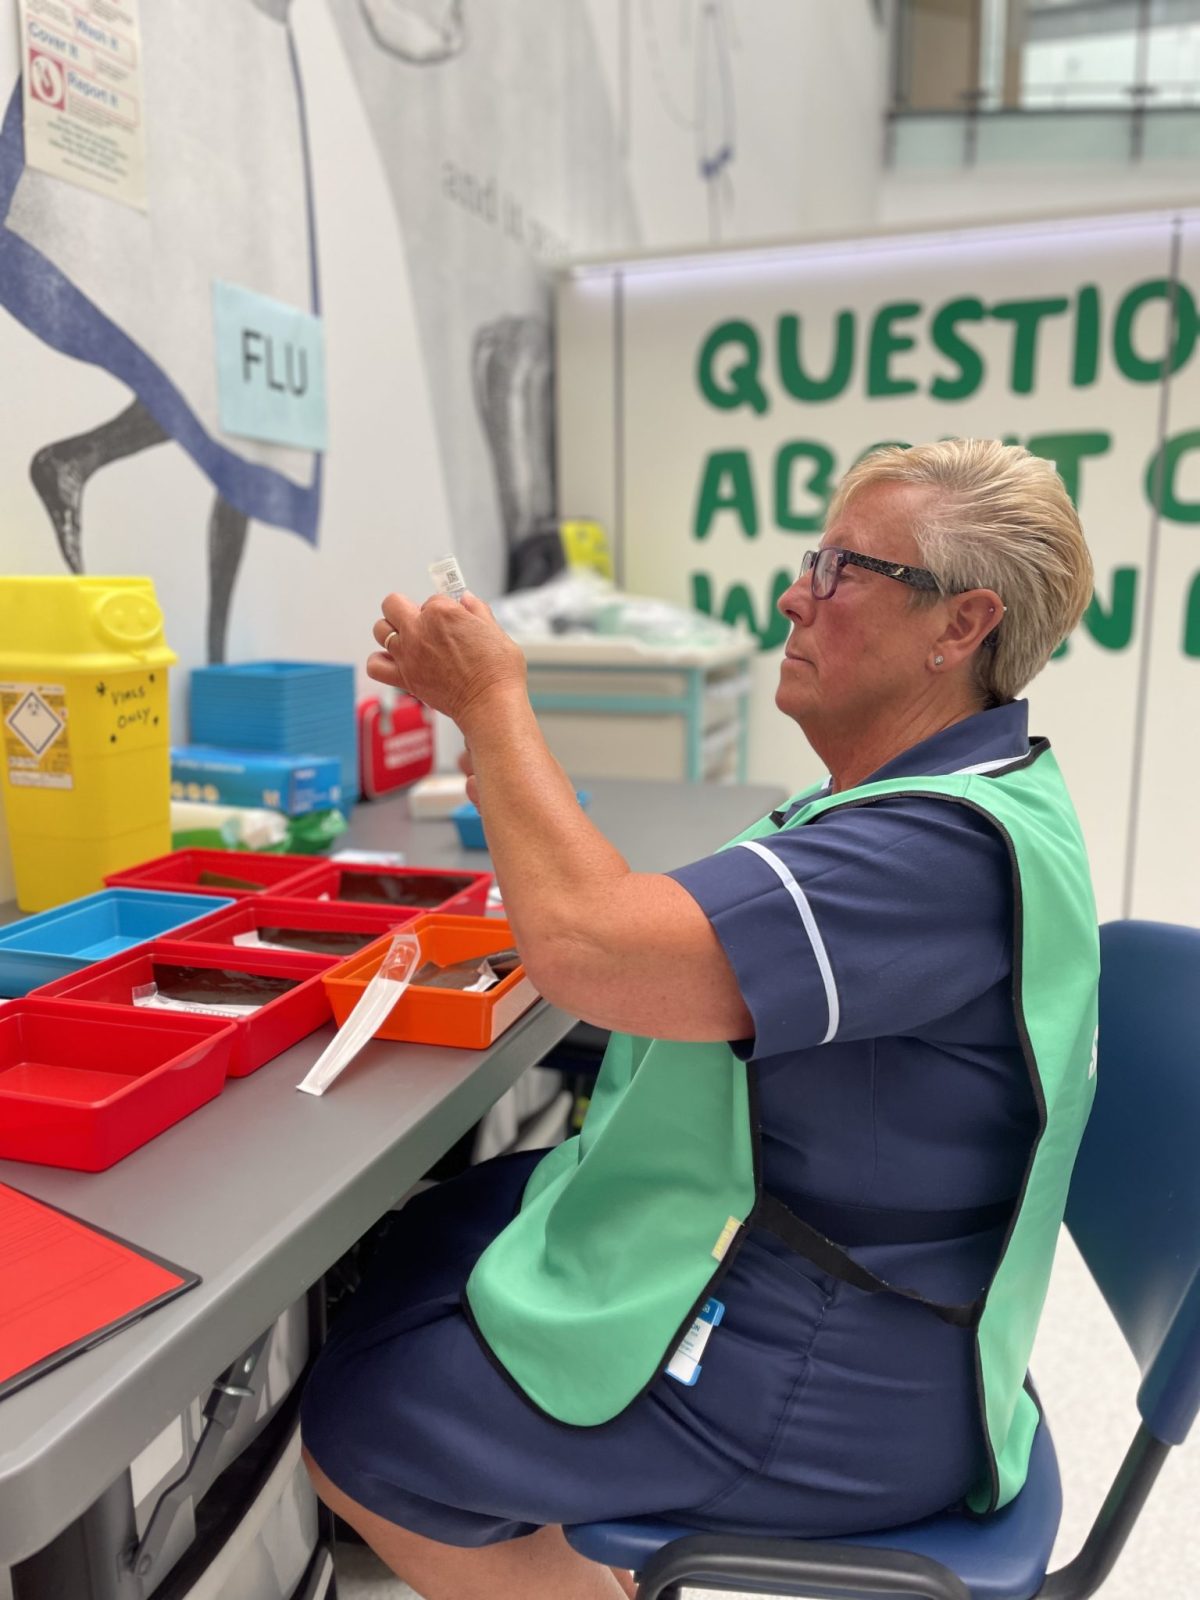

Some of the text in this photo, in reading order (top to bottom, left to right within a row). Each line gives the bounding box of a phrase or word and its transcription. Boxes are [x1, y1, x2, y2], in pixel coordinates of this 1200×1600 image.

[242, 326, 308, 398] FLU
[697, 278, 1200, 416] QUESTIO
[693, 431, 1111, 541] ABT
